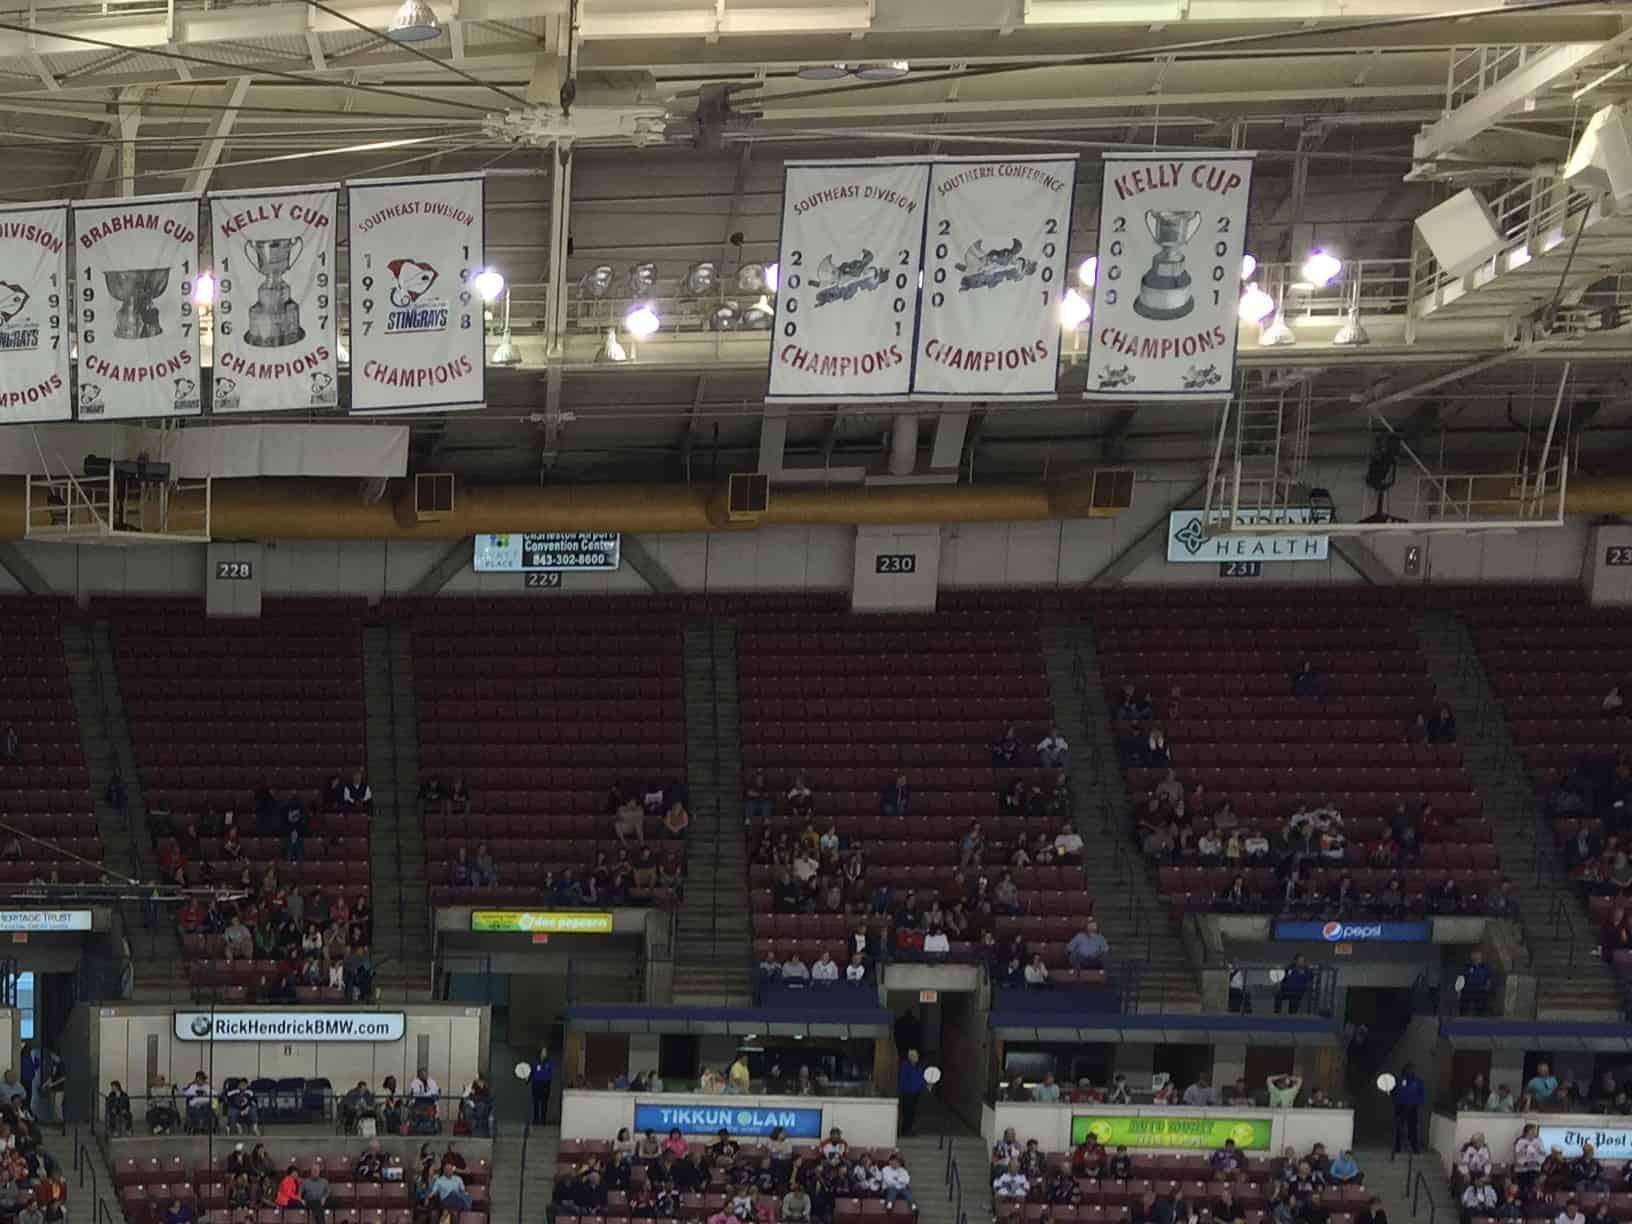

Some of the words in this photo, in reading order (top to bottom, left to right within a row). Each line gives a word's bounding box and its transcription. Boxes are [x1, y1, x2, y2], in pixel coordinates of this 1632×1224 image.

[937, 165, 996, 197] SOUTHERN
[997, 163, 1065, 193] CONFERENCE
[1113, 162, 1184, 201] KELLY
[1191, 164, 1242, 196] CUP
[792, 184, 862, 217] SOUTHEAST
[863, 185, 918, 215] DIVISION
[79, 213, 160, 250] BRABHAM
[163, 219, 196, 244] CUP
[220, 203, 284, 239] KELLY
[289, 204, 330, 229] CUP
[358, 201, 421, 234] SOUTHEAST
[423, 201, 475, 227] DIVISION
[387, 308, 449, 331] STINGRAYS
[924, 338, 1050, 373] CHAMPIONS
[1099, 325, 1226, 360] CHAMPIONS
[84, 349, 193, 383] CHAMPIONS
[220, 346, 330, 380] CHAMPIONS
[363, 354, 473, 388] CHAMPIONS
[780, 343, 904, 377] CHAMPIONS
[524, 539, 579, 552] Convention
[1215, 539, 1318, 555] HEALTH
[220, 564, 250, 578] 228
[528, 574, 559, 586] 229
[879, 557, 913, 572] 230
[1227, 562, 1256, 577] 231
[1343, 925, 1382, 939] pepsi
[215, 1018, 390, 1035] RickHendrickBMW.com
[660, 1107, 733, 1126] TIKKUN
[1564, 1130, 1590, 1147] The
[1595, 1131, 1627, 1148] Post
